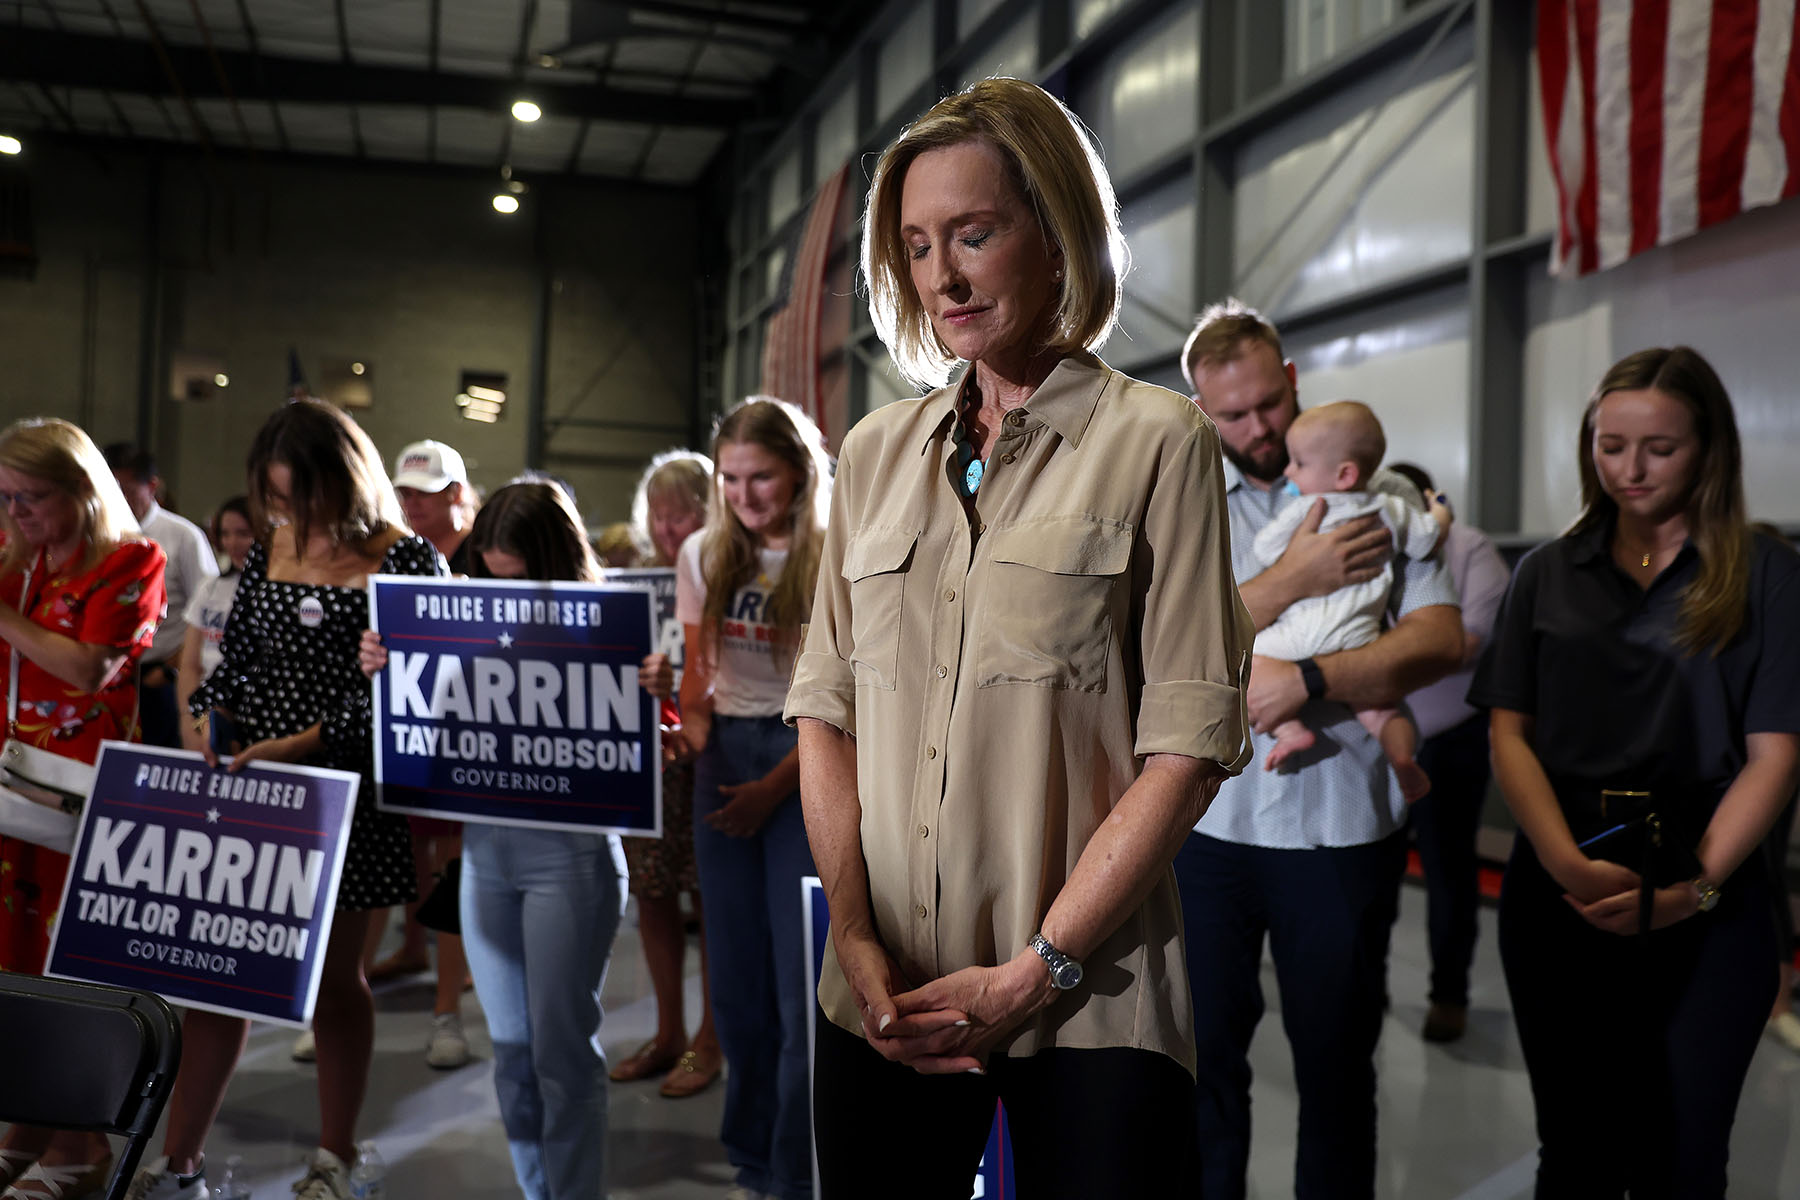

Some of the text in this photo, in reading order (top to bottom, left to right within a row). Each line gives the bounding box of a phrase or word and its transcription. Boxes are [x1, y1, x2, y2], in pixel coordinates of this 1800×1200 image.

[415, 594, 602, 627] POLICE ENDORSED
[389, 650, 641, 732] KARRIN
[391, 723, 641, 773] TAYLOR ROBSON
[135, 763, 307, 810] POLICE ENDORSED
[452, 767, 572, 793] GOVERNOR
[83, 816, 325, 920] KARRIN
[77, 889, 310, 961] TAYLOR ROBSON
[126, 939, 238, 976] GOVERNOR
